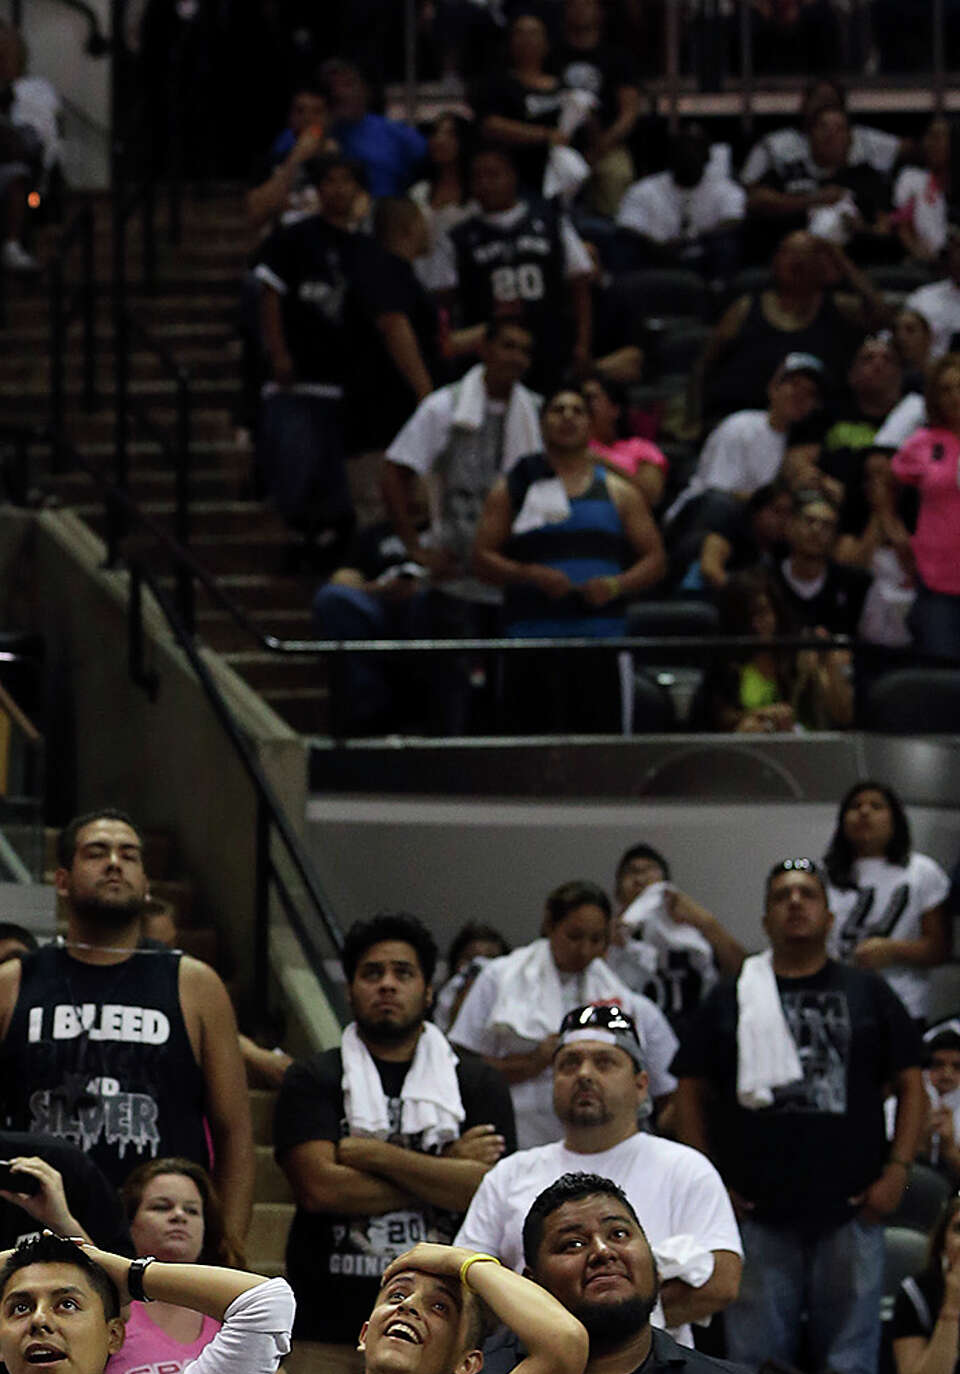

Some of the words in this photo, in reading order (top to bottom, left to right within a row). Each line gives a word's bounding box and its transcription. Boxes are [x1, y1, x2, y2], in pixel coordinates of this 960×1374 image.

[27, 1006, 44, 1044] I
[52, 1003, 171, 1046] BLEED
[388, 1219, 422, 1244] 20
